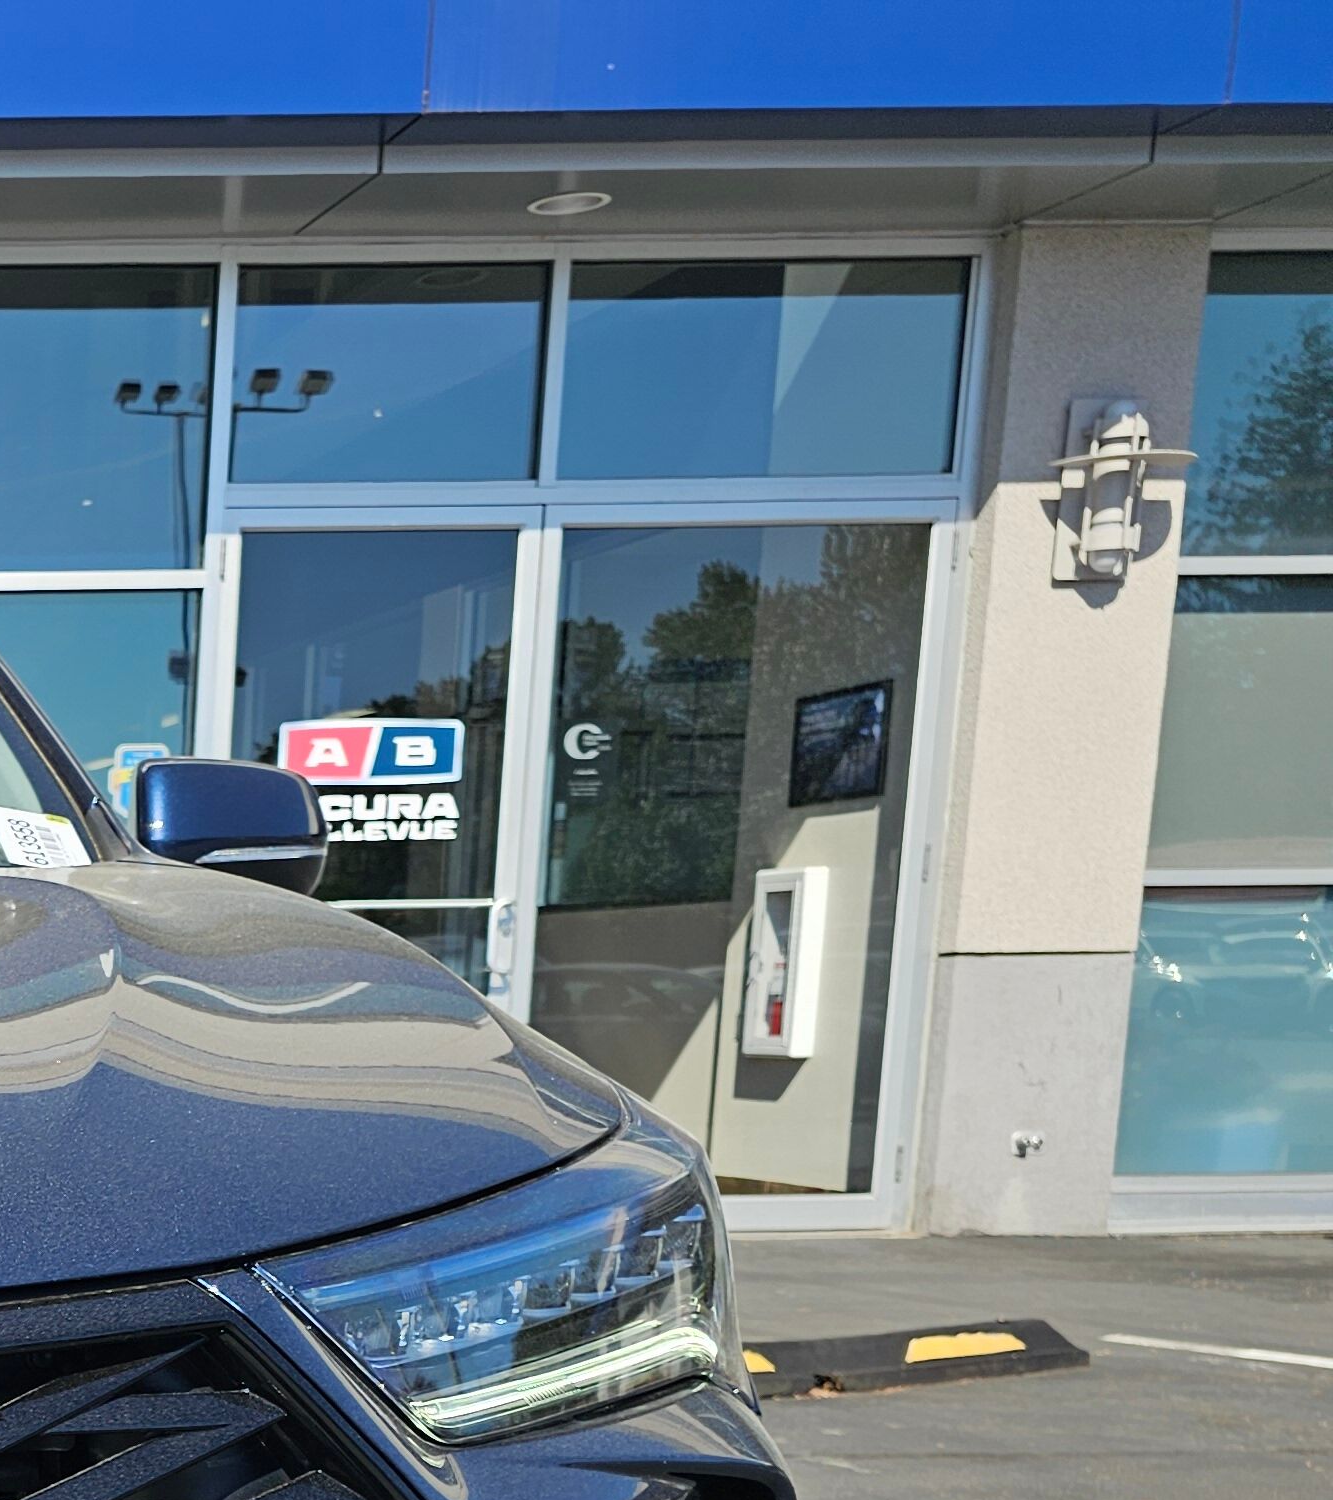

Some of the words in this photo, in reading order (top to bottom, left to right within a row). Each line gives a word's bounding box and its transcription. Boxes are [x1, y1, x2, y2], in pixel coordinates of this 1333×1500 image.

[304, 738, 349, 767] A
[392, 736, 437, 766] B
[318, 792, 460, 821] CURA
